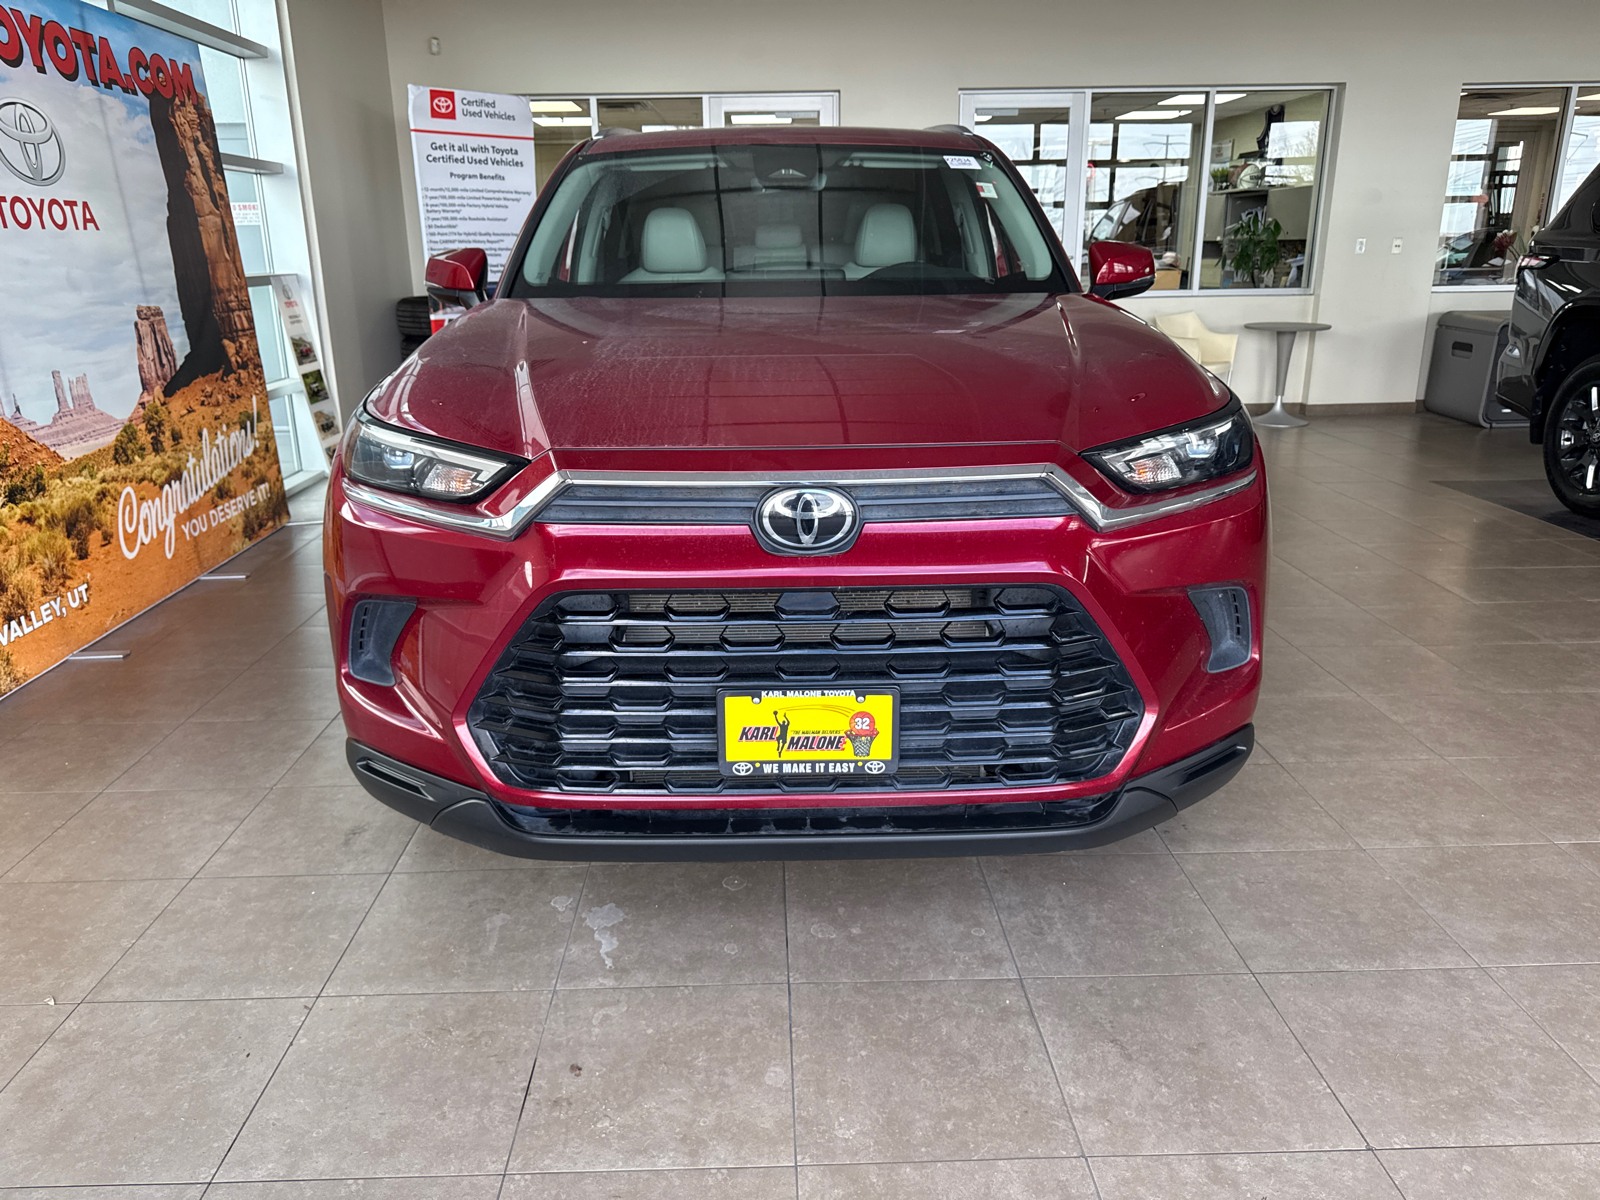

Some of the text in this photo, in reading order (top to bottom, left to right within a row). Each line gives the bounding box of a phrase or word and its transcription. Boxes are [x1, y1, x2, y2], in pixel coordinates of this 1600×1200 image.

[460, 97, 496, 108] Certified
[461, 108, 516, 121] Used Vehicles
[430, 142, 518, 157] Get it all with Toyota
[426, 154, 524, 167] Certified Used Vehicles
[449, 172, 505, 181] Program Benefits
[0, 195, 100, 231] TOYOTA
[118, 395, 259, 559] Congratulations!
[181, 482, 271, 540] YOU DESERVE IT!
[0, 583, 88, 647] VALLEY, UT
[761, 690, 785, 698] KARL
[854, 717, 870, 730] 32
[738, 726, 779, 741] KARL
[786, 736, 846, 751] MALONE
[762, 762, 856, 774] WE MAKE IT EASY
